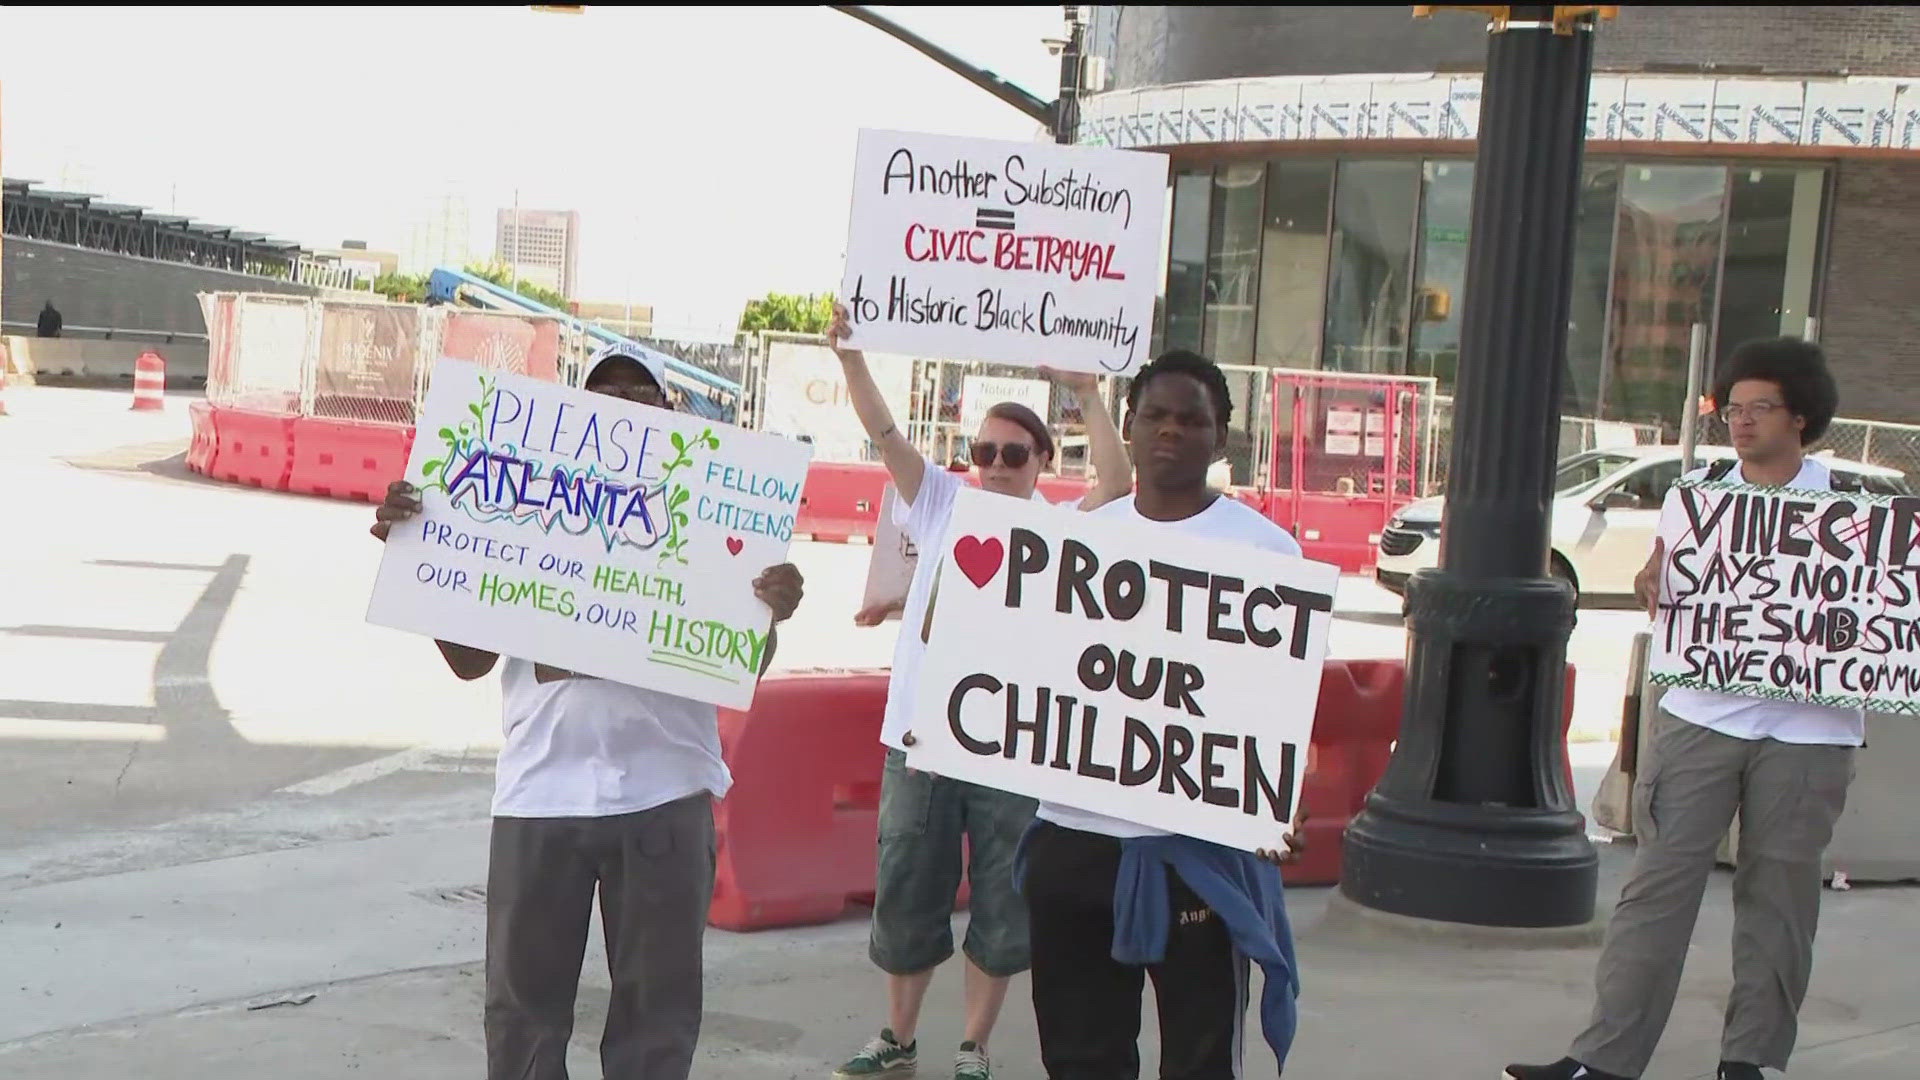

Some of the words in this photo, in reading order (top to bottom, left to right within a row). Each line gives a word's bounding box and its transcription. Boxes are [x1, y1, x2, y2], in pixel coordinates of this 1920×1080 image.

[883, 147, 997, 198] Another
[1004, 154, 1132, 230] Substation
[905, 222, 988, 264] CIVIC
[994, 233, 1126, 283] BETRAYAL
[850, 274, 879, 324] to
[888, 275, 968, 326] Historic
[975, 287, 1036, 333] Black
[1038, 291, 1139, 373] Community
[488, 388, 662, 481] PLEASE
[447, 449, 653, 534] ATLANTA
[697, 495, 795, 543] CITIZENS
[705, 460, 801, 506] FELLOW
[422, 519, 530, 566] PROTECT
[539, 552, 586, 582] OUR
[593, 564, 687, 607] HEALTH,
[1004, 527, 1333, 661] PROTECT
[1672, 547, 1781, 600] SAYS
[1790, 561, 1878, 605] NO!!
[416, 561, 473, 593] OUR
[478, 572, 582, 622] HOMES,
[586, 603, 639, 635] OUR
[648, 610, 769, 675] HISTORY
[1659, 601, 1754, 654] THE
[1077, 643, 1206, 718] OUR
[1680, 645, 1769, 688] SAVE
[946, 672, 1297, 825] CHILDREN
